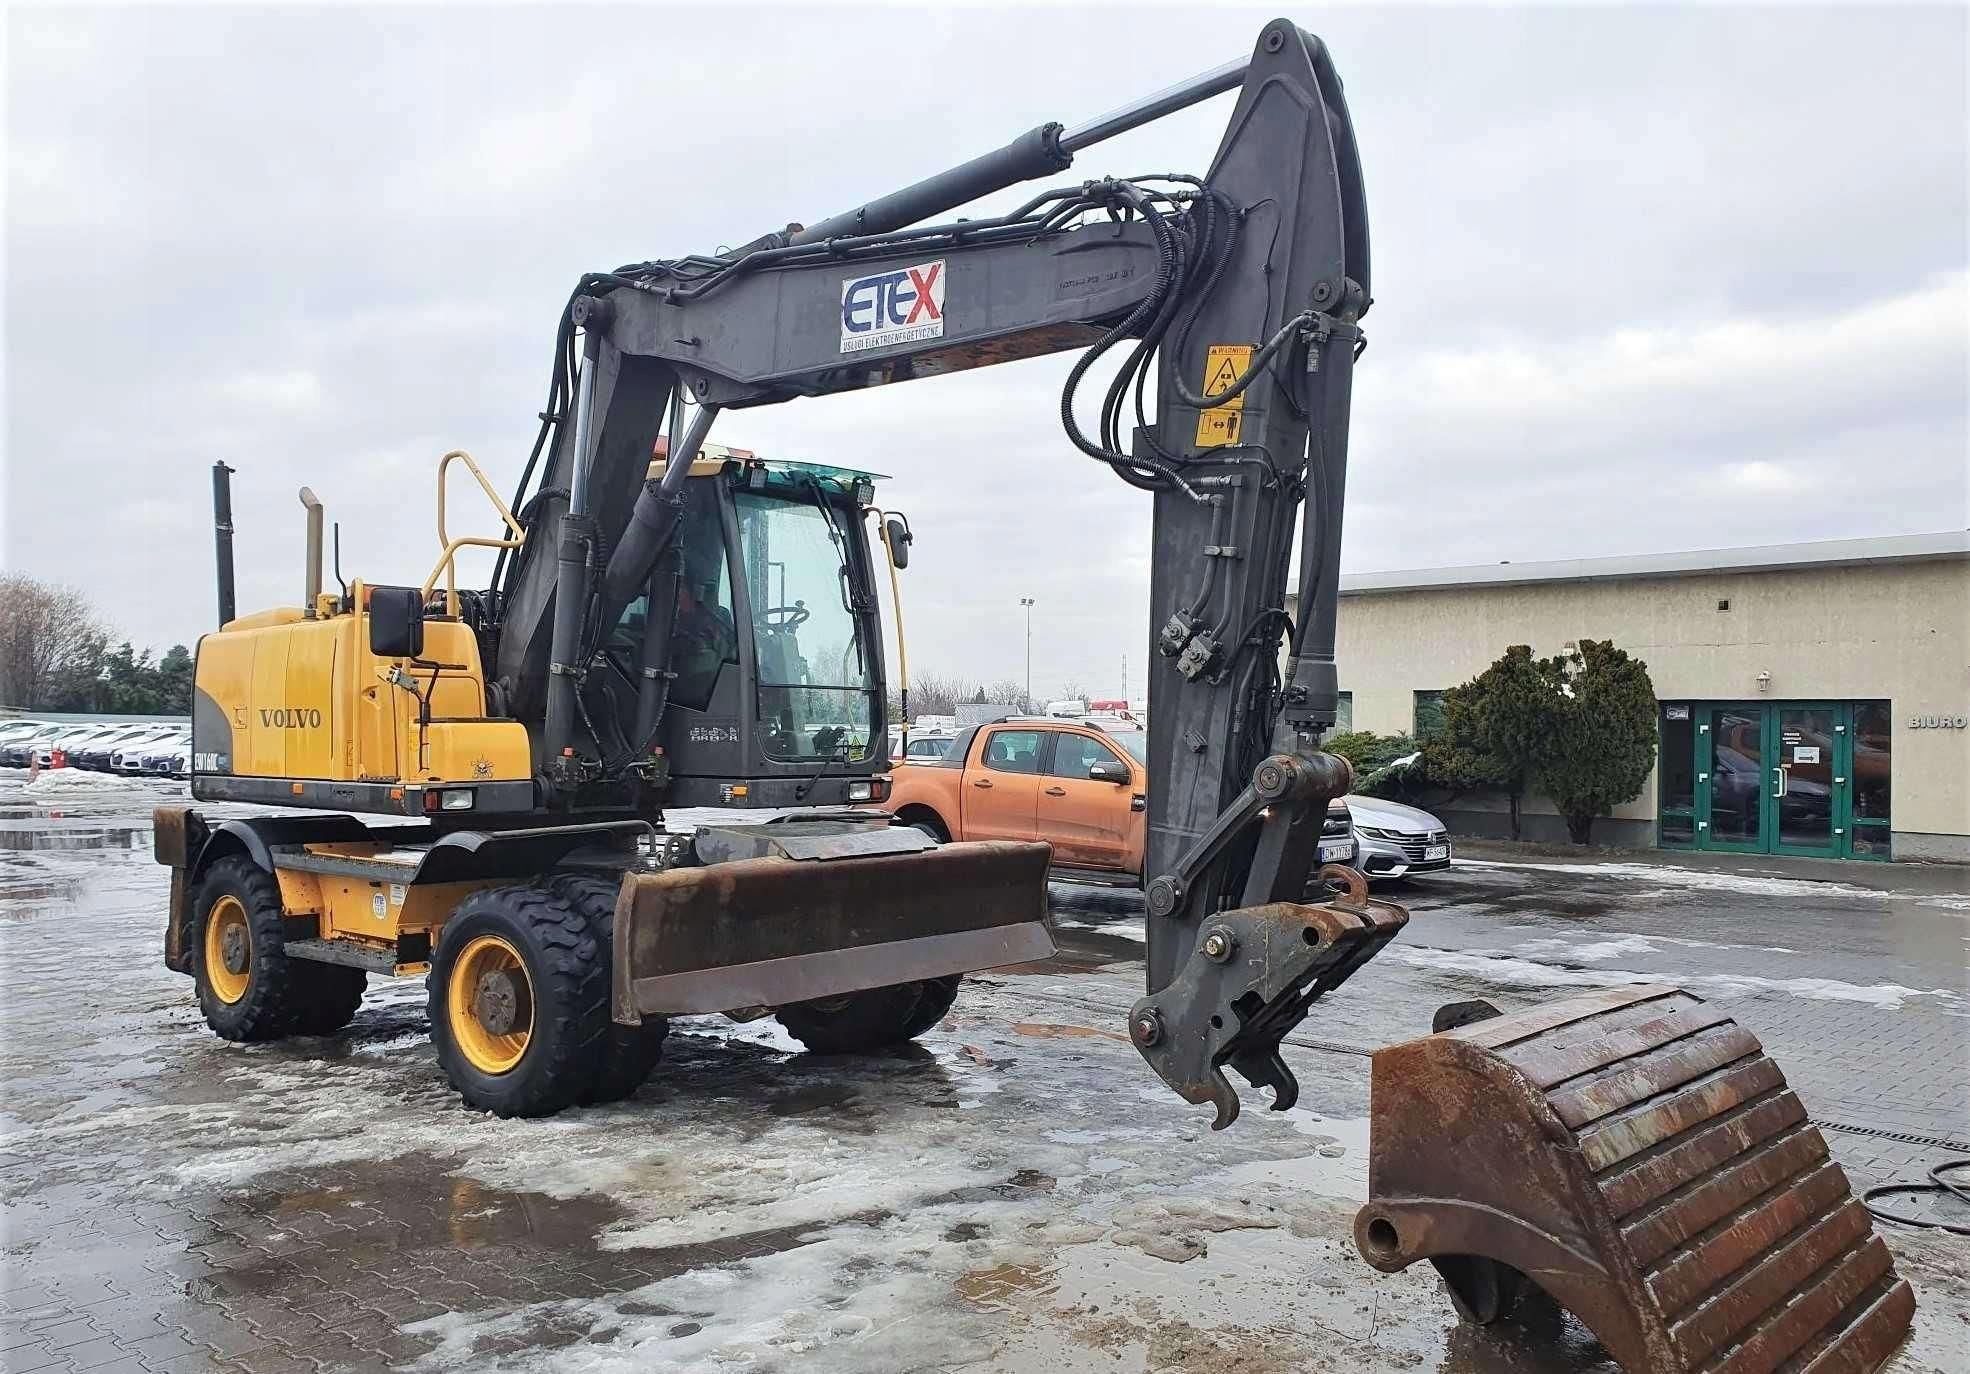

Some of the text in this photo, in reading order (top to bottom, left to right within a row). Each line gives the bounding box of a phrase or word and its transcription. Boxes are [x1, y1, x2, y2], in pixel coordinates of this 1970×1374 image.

[844, 264, 941, 332] ETEX
[259, 708, 321, 728] VOLVO
[1908, 714, 1968, 729] BIURO
